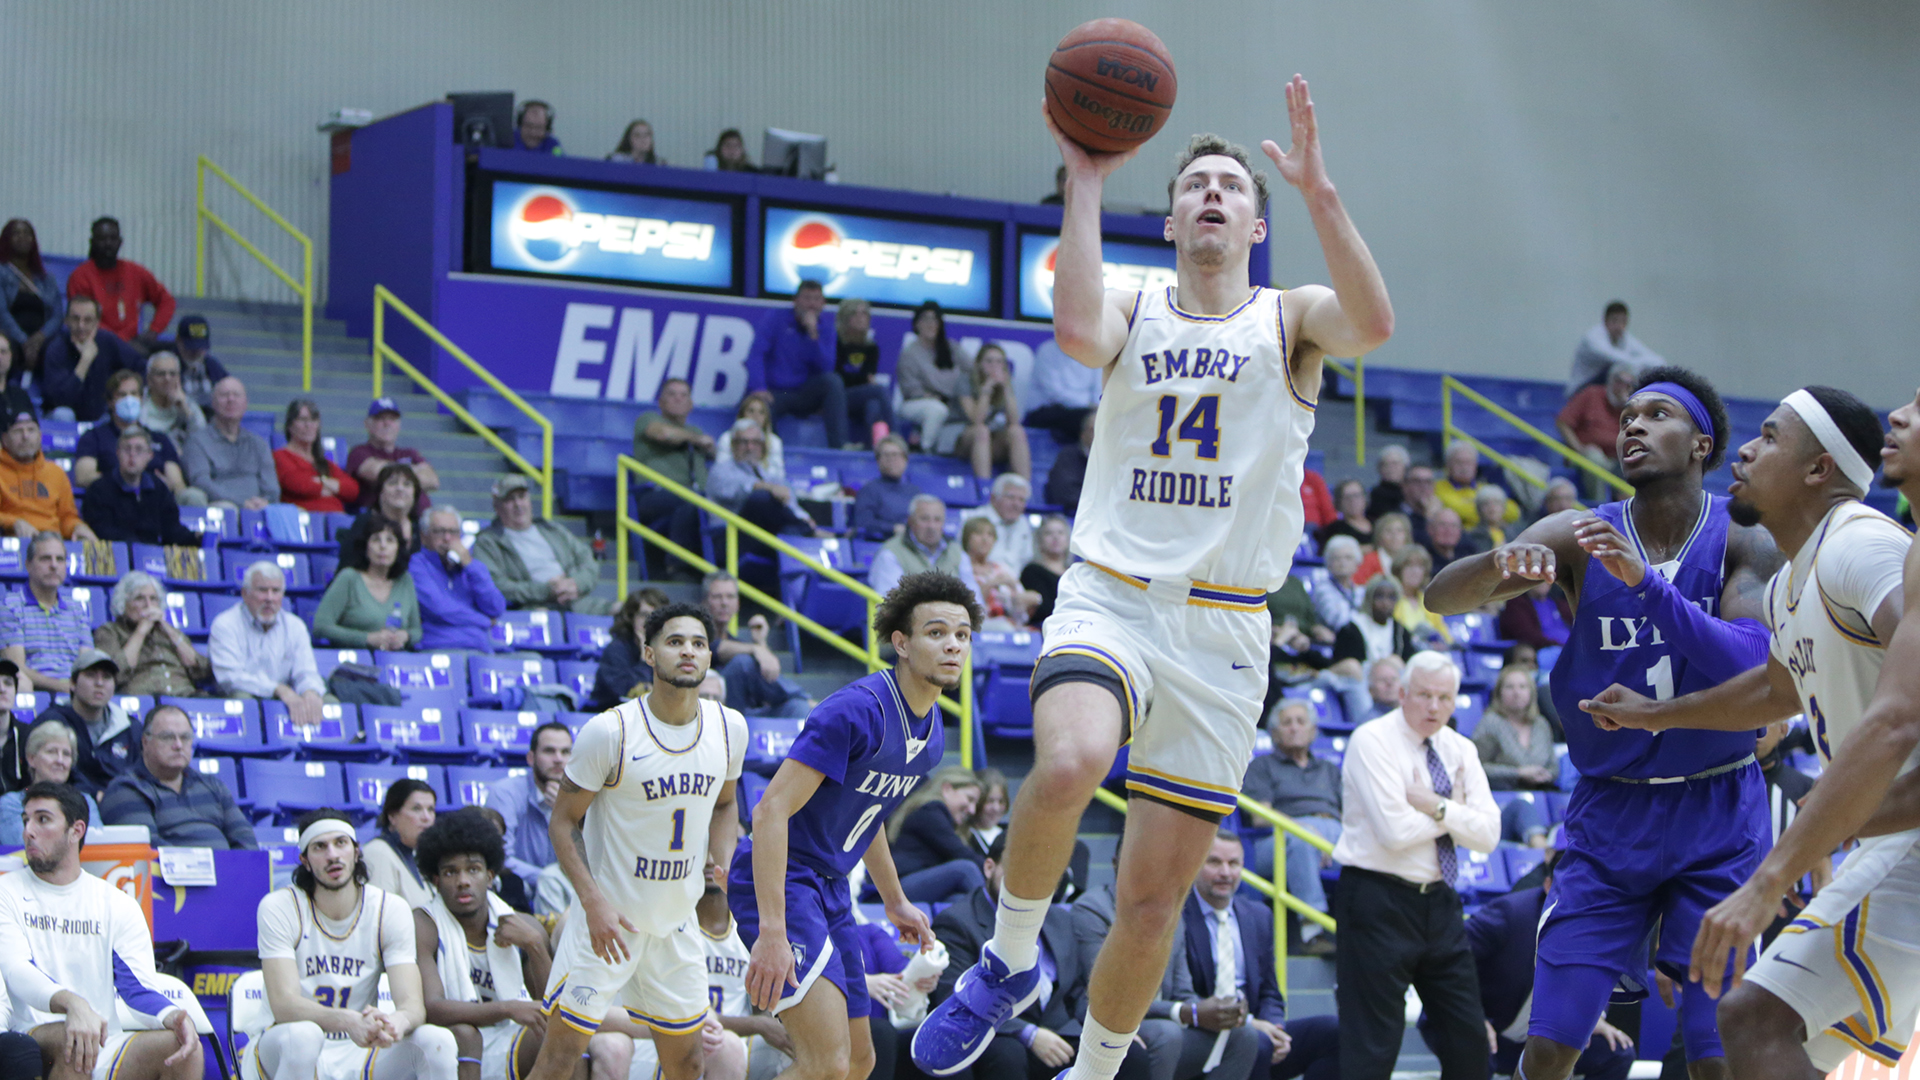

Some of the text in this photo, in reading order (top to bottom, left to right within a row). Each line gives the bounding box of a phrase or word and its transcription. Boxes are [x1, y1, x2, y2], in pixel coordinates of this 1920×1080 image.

[1097, 57, 1160, 92] NCAA
[1073, 89, 1155, 133] Wilson
[567, 212, 716, 261] PEPSI
[839, 238, 975, 287] PEPSI
[1102, 262, 1178, 292] PEP
[549, 302, 756, 409] EMB
[1140, 347, 1251, 386] EMBRY
[1150, 393, 1222, 462] 14
[1129, 467, 1234, 508] RIDDLE
[1646, 654, 1675, 736] 1
[641, 772, 716, 802] EMBRY
[668, 807, 686, 852] 1
[842, 803, 882, 853] 0
[24, 911, 102, 936] EMBRY-RIDDLE
[305, 954, 365, 978] EMBRY
